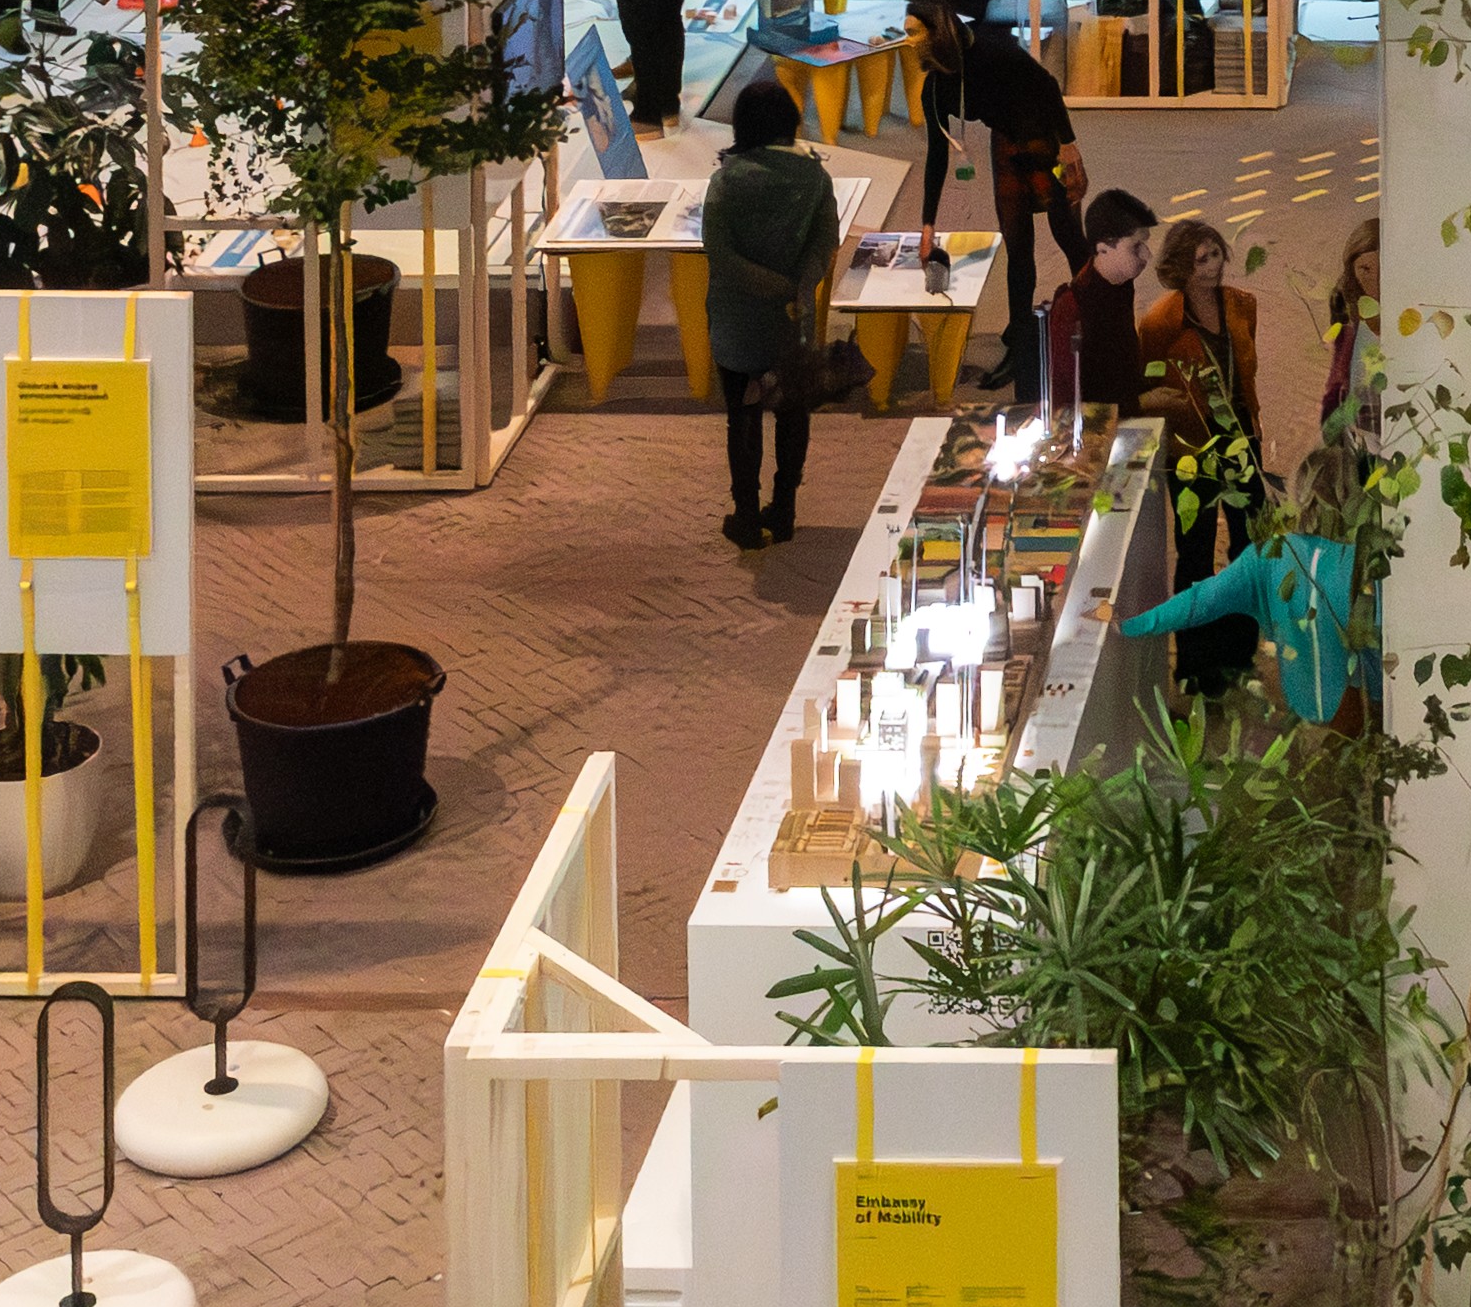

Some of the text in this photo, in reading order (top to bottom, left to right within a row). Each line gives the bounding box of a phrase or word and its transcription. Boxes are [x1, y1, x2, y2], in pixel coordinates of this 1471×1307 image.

[855, 1194, 926, 1210] Embassy
[855, 1210, 942, 1227] of Mobility
